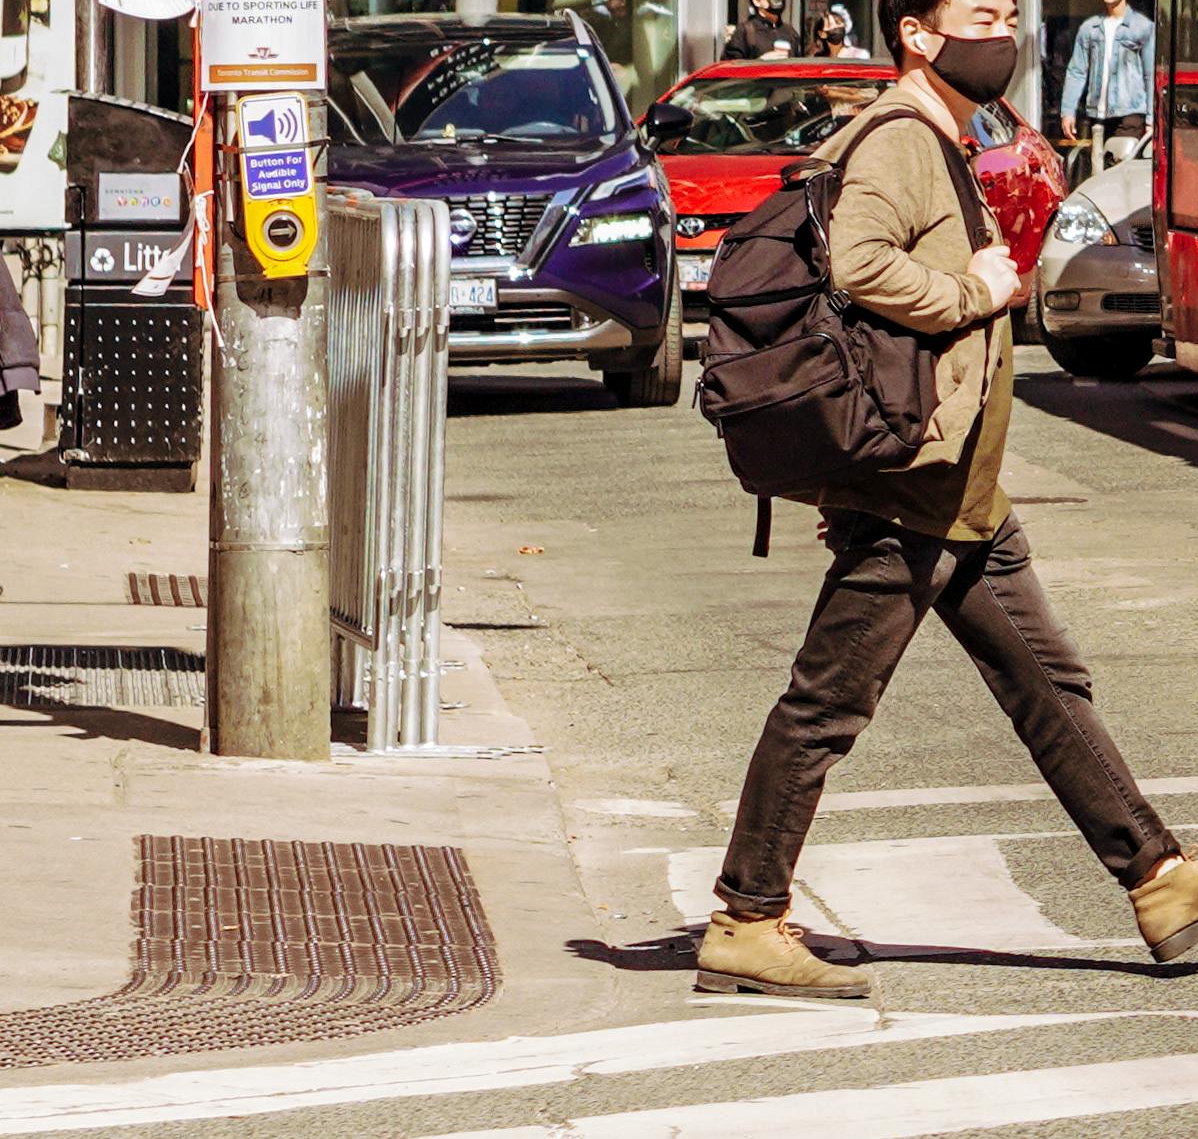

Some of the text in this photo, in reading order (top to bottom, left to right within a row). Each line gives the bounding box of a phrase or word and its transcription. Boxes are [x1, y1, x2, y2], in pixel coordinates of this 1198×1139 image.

[207, 0, 318, 11] DUE TO SPORTING LIFE
[232, 15, 293, 25] MARATHON
[250, 156, 302, 169] Button For
[258, 168, 296, 179] Audible
[251, 179, 306, 193] Signal Only
[124, 242, 180, 271] Litt
